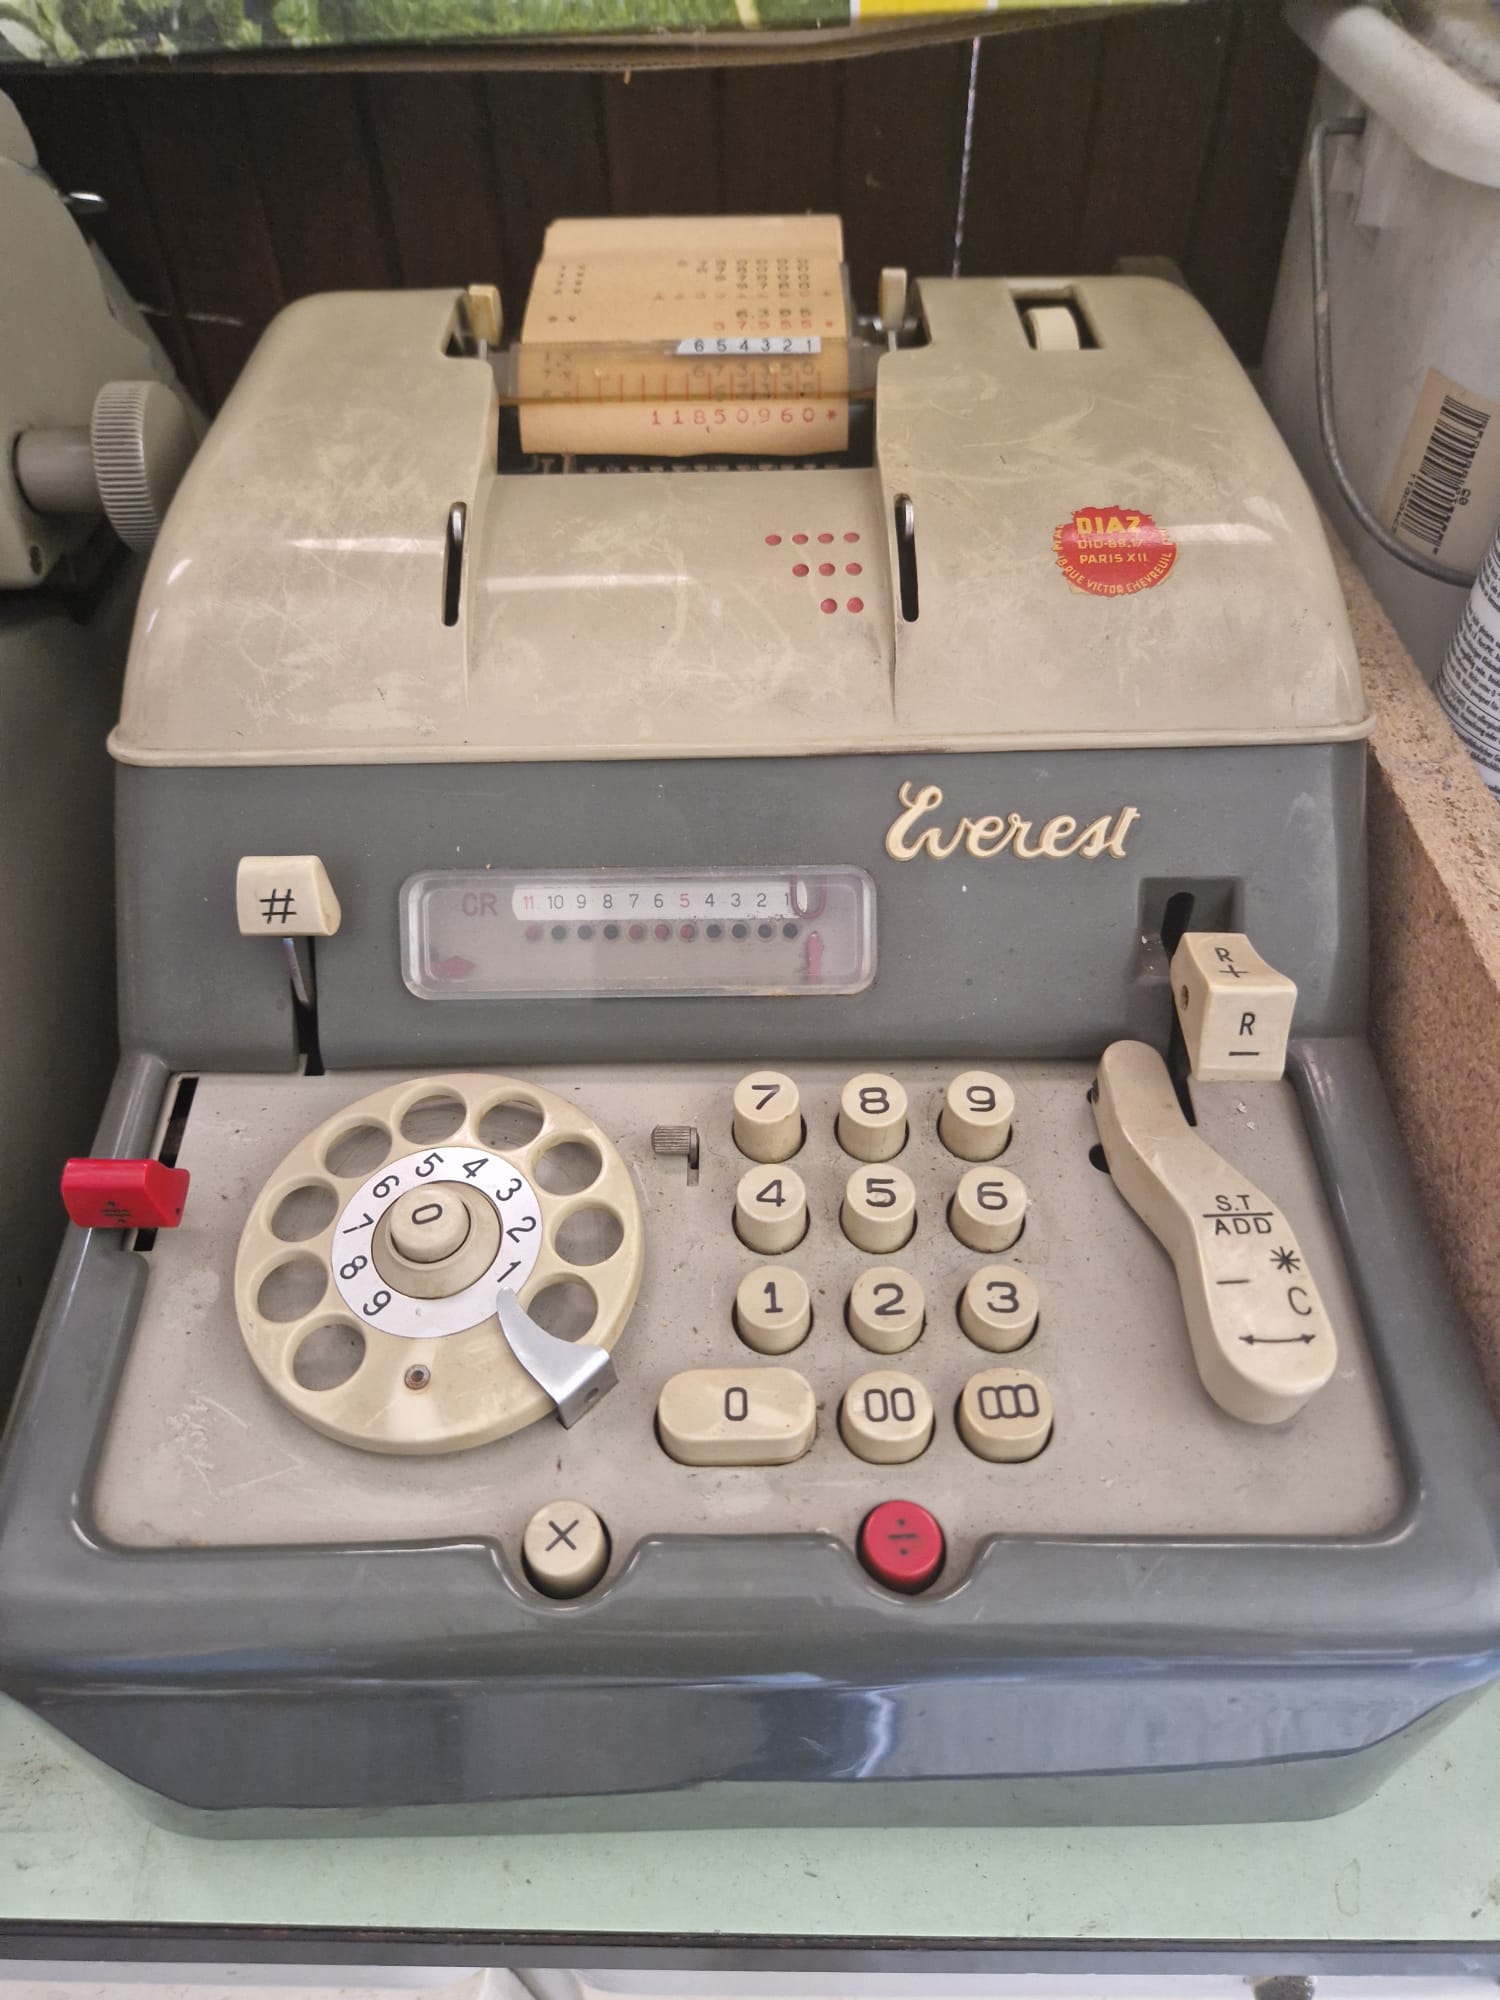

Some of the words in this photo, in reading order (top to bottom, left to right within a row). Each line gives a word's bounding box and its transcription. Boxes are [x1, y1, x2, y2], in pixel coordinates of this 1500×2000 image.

[694, 339, 705, 352] 6
[716, 339, 727, 352] 5
[739, 339, 749, 351] 4
[760, 339, 771, 351] 3
[783, 338, 793, 351] 2
[806, 339, 812, 351] 1
[1076, 516, 1141, 535] DIAZ
[1079, 553, 1123, 564] PARIS
[1064, 565, 1086, 584] RUE
[1087, 579, 1124, 594] VICTOR
[1126, 552, 1173, 593] CHEVREUIL
[886, 781, 1141, 861] Everest
[259, 888, 298, 924] #
[461, 893, 499, 917] CR
[523, 895, 536, 911] 11
[548, 894, 566, 911] 10
[576, 894, 587, 910] 9
[602, 893, 614, 909] 8
[628, 893, 640, 909] 7
[653, 893, 664, 909] 6
[679, 893, 691, 909] 5
[704, 893, 716, 909] 4
[730, 893, 742, 909] 3
[756, 893, 767, 908] 2
[783, 893, 790, 908] 1
[1215, 947, 1233, 963] R
[1239, 1012, 1254, 1036] R
[751, 1084, 780, 1110] 7
[859, 1087, 890, 1114] 8
[966, 1086, 997, 1112] 9
[416, 1152, 444, 1177] 5
[462, 1158, 489, 1179] 4
[372, 1175, 400, 1198] 6
[495, 1178, 522, 1201] 3
[755, 1179, 786, 1207] 4
[865, 1178, 896, 1208] 5
[976, 1181, 1008, 1210] 6
[343, 1212, 375, 1234] 7
[411, 1203, 443, 1225] 0
[506, 1216, 536, 1243] 2
[1214, 1217, 1272, 1236] ADD
[340, 1255, 368, 1279] 8
[497, 1260, 521, 1283] 1
[363, 1290, 391, 1316] 9
[763, 1281, 783, 1313] 1
[873, 1283, 906, 1316] 2
[986, 1281, 1019, 1313] 3
[1288, 1287, 1312, 1316] C
[724, 1386, 748, 1421] 0
[863, 1387, 915, 1422] 00
